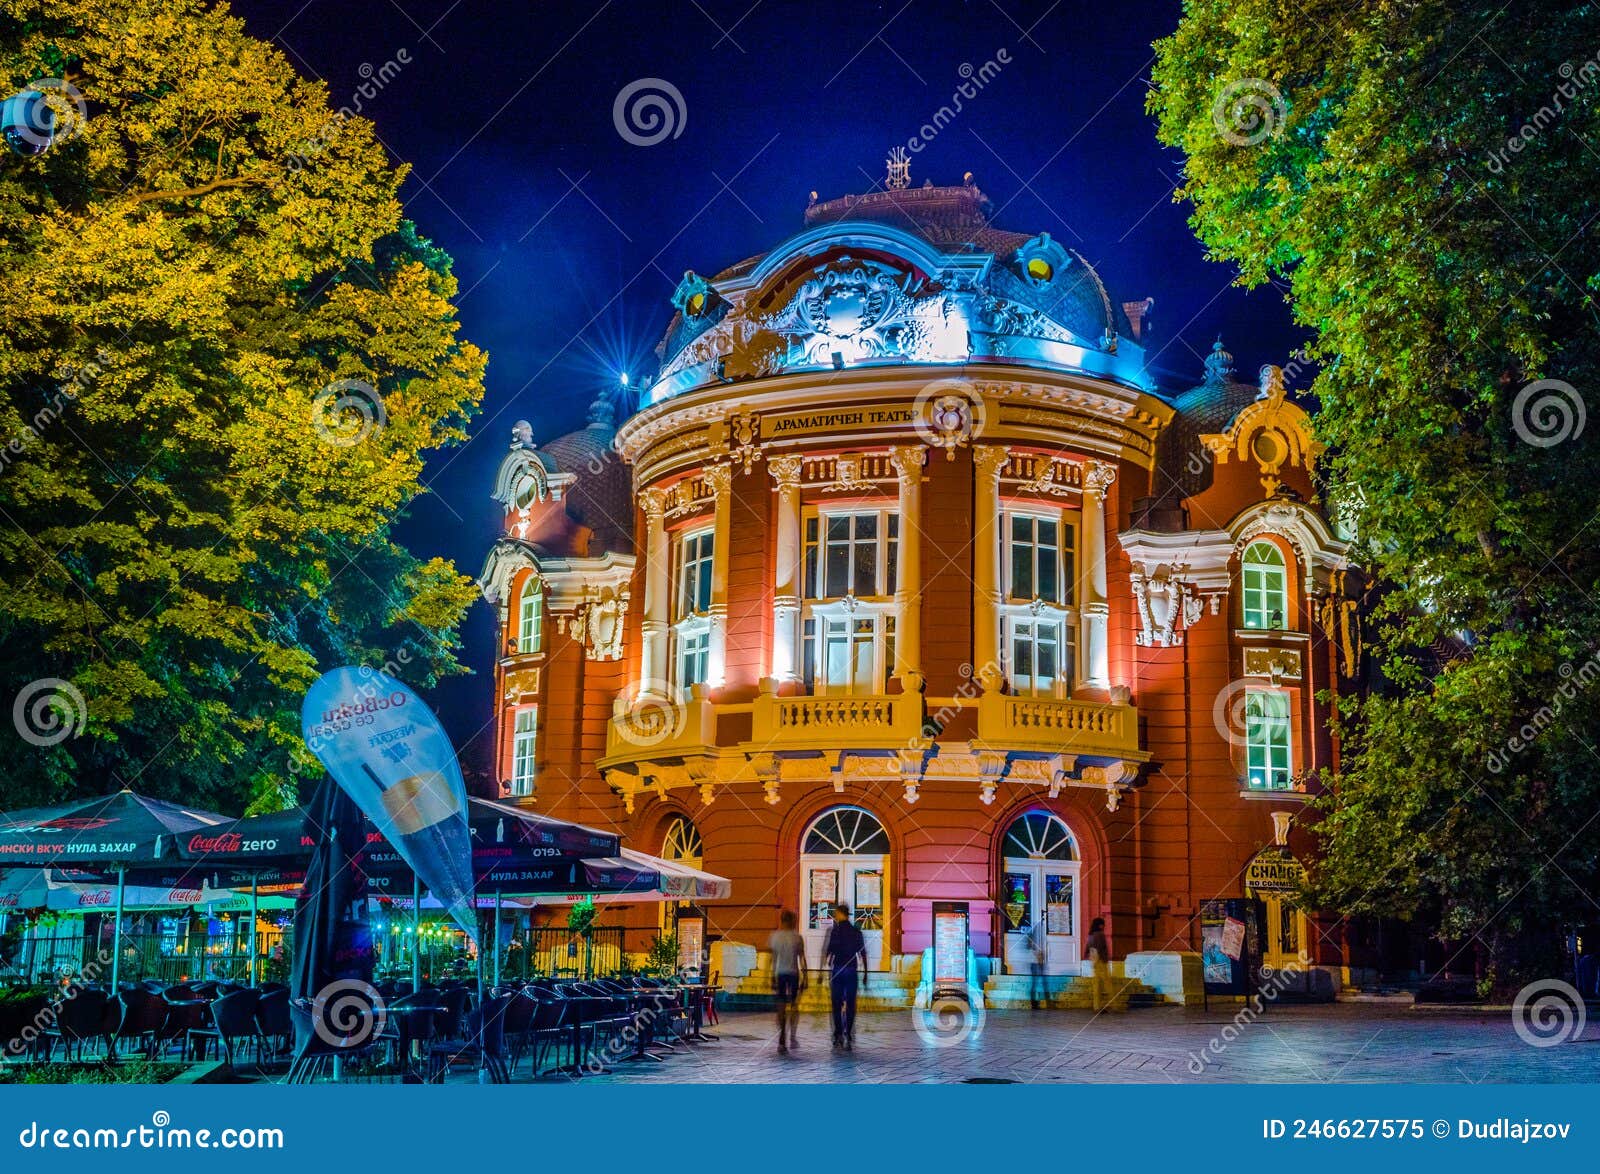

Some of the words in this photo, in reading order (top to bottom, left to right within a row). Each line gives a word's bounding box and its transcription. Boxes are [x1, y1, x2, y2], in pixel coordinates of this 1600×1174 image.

[774, 413, 863, 431] ДРАМАТИЧЕН
[868, 410, 918, 423] ТЕАТЪР
[37, 844, 65, 854] ВКУС
[67, 843, 97, 853] НУЛА
[99, 842, 136, 853] ЗАХАР
[242, 839, 276, 851] zero
[491, 872, 518, 881] НУЛА
[520, 870, 554, 880] ЗАХАР
[1251, 866, 1303, 879] CHANGE
[368, 877, 390, 887] ero
